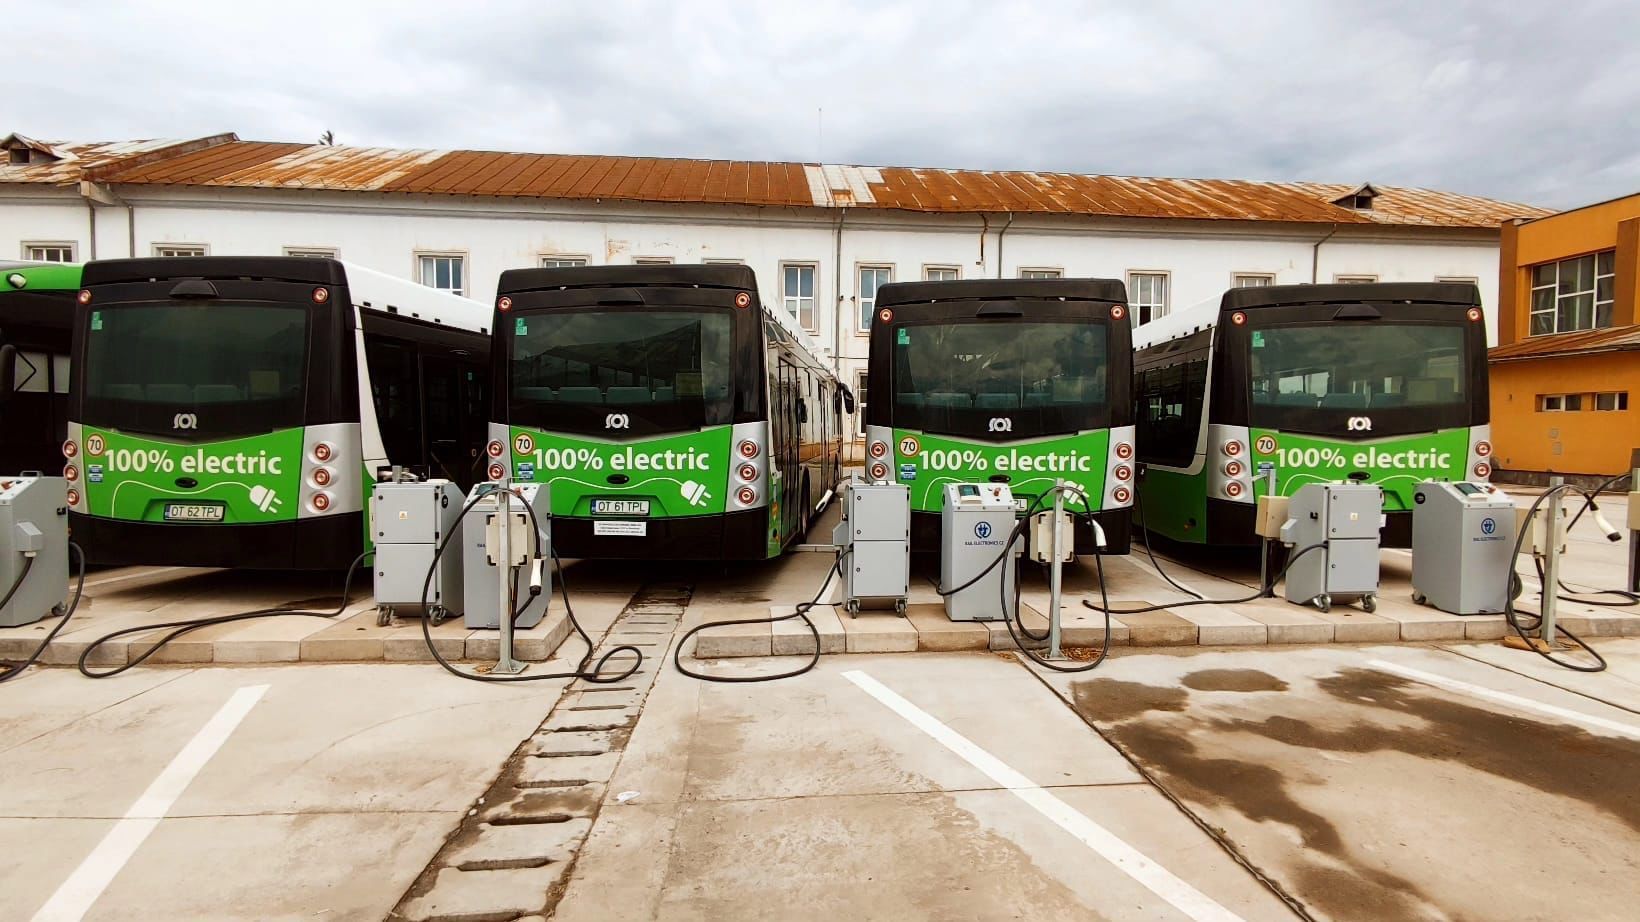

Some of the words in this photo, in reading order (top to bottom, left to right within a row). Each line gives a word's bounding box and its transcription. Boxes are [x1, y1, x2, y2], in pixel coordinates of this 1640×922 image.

[89, 439, 101, 451] 70
[517, 439, 530, 450] 70
[903, 441, 915, 452] 70
[1259, 439, 1273, 450] 70
[105, 448, 174, 473] 100%
[181, 448, 282, 475] electric
[532, 447, 604, 471] 100%
[609, 446, 710, 471] electric
[919, 449, 988, 471] 100%
[994, 448, 1091, 472] electric
[1275, 447, 1346, 469] 100%
[1352, 446, 1451, 469] electric
[171, 506, 184, 517] OT
[187, 505, 199, 517] 62
[201, 506, 220, 518] TPL
[598, 501, 611, 512] OT
[614, 501, 624, 512] 61
[626, 502, 646, 512] TPL
